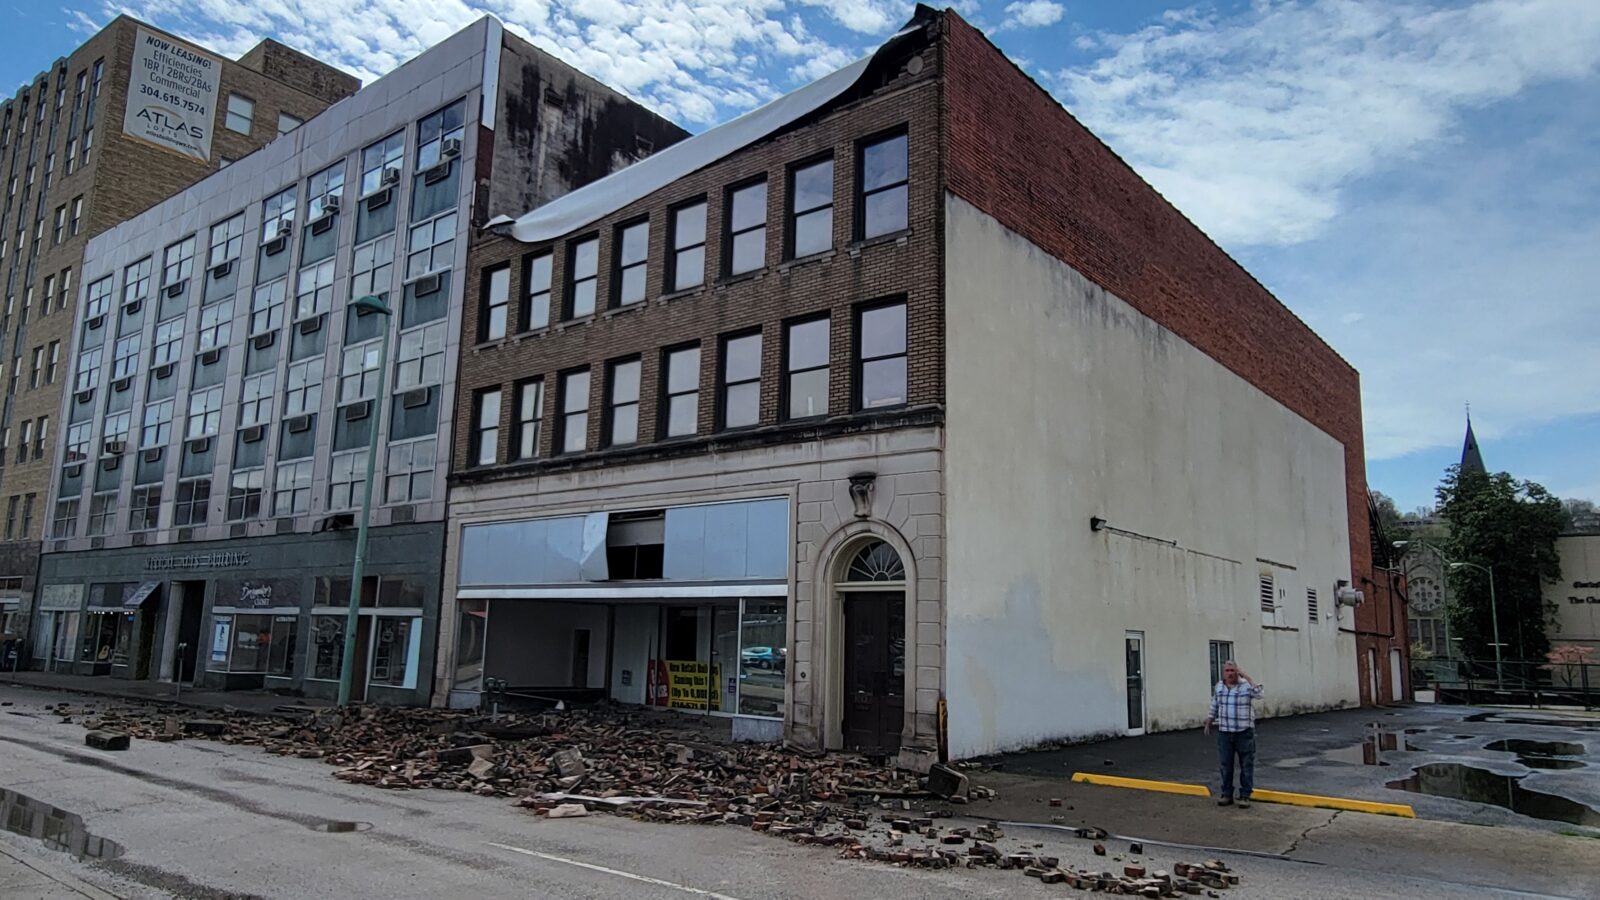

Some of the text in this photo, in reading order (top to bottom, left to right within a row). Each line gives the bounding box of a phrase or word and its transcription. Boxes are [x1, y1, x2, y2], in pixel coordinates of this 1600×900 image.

[146, 36, 212, 69] NOW LEASING!
[153, 50, 203, 78] Efficiencies
[143, 58, 212, 93] 1BR 2BRs/2BAs
[150, 72, 200, 98] Commercial
[140, 84, 205, 115] 304.615.7574
[136, 108, 204, 139] ATLAS
[147, 123, 178, 138] LOFTS
